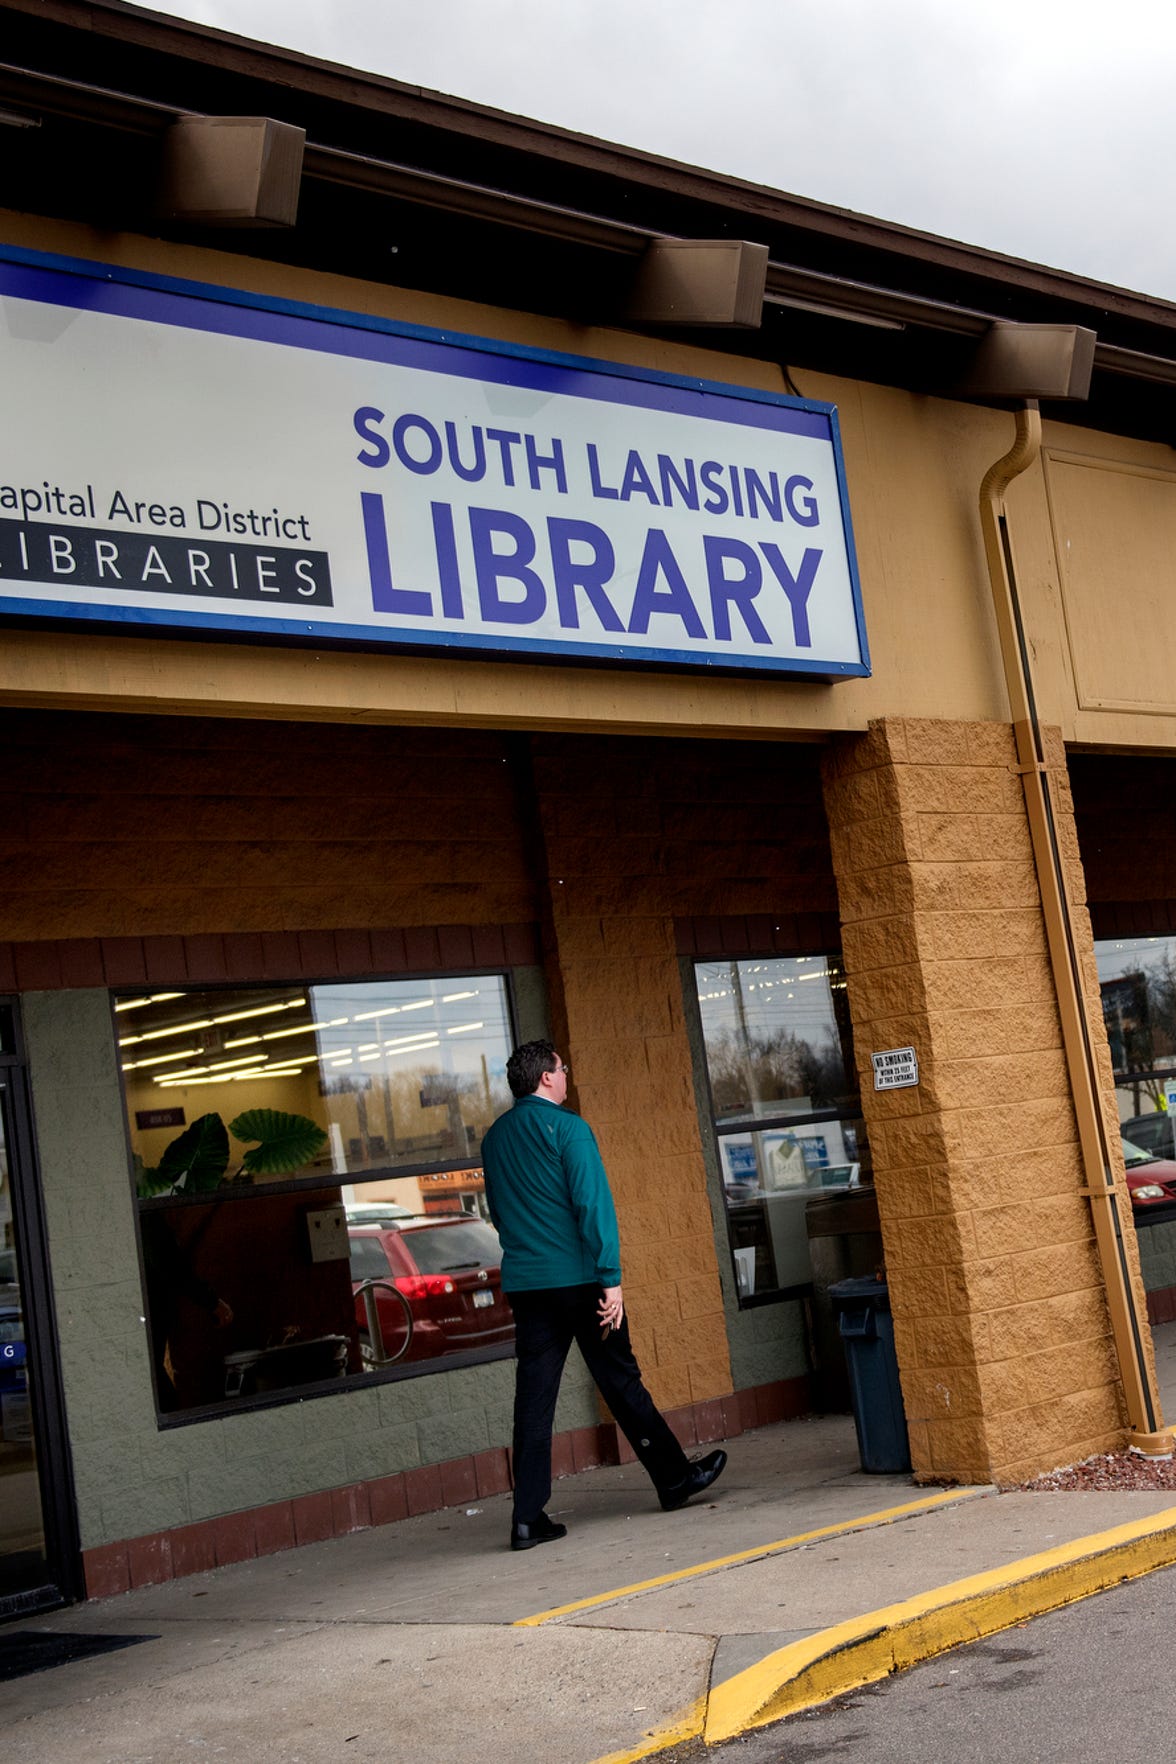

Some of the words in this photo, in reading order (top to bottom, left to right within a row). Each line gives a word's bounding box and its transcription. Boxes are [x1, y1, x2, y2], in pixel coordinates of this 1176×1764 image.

[353, 406, 568, 494] SOUTH
[586, 443, 820, 527] LANSING
[0, 481, 95, 521] apital
[108, 490, 186, 528] Area
[196, 500, 311, 541] District
[0, 532, 317, 596] IBRARIES
[360, 491, 824, 648] LIBRARY
[875, 1057, 884, 1067] NO
[885, 1052, 912, 1066] SMOKING
[894, 1072, 914, 1082] ENTRANCE
